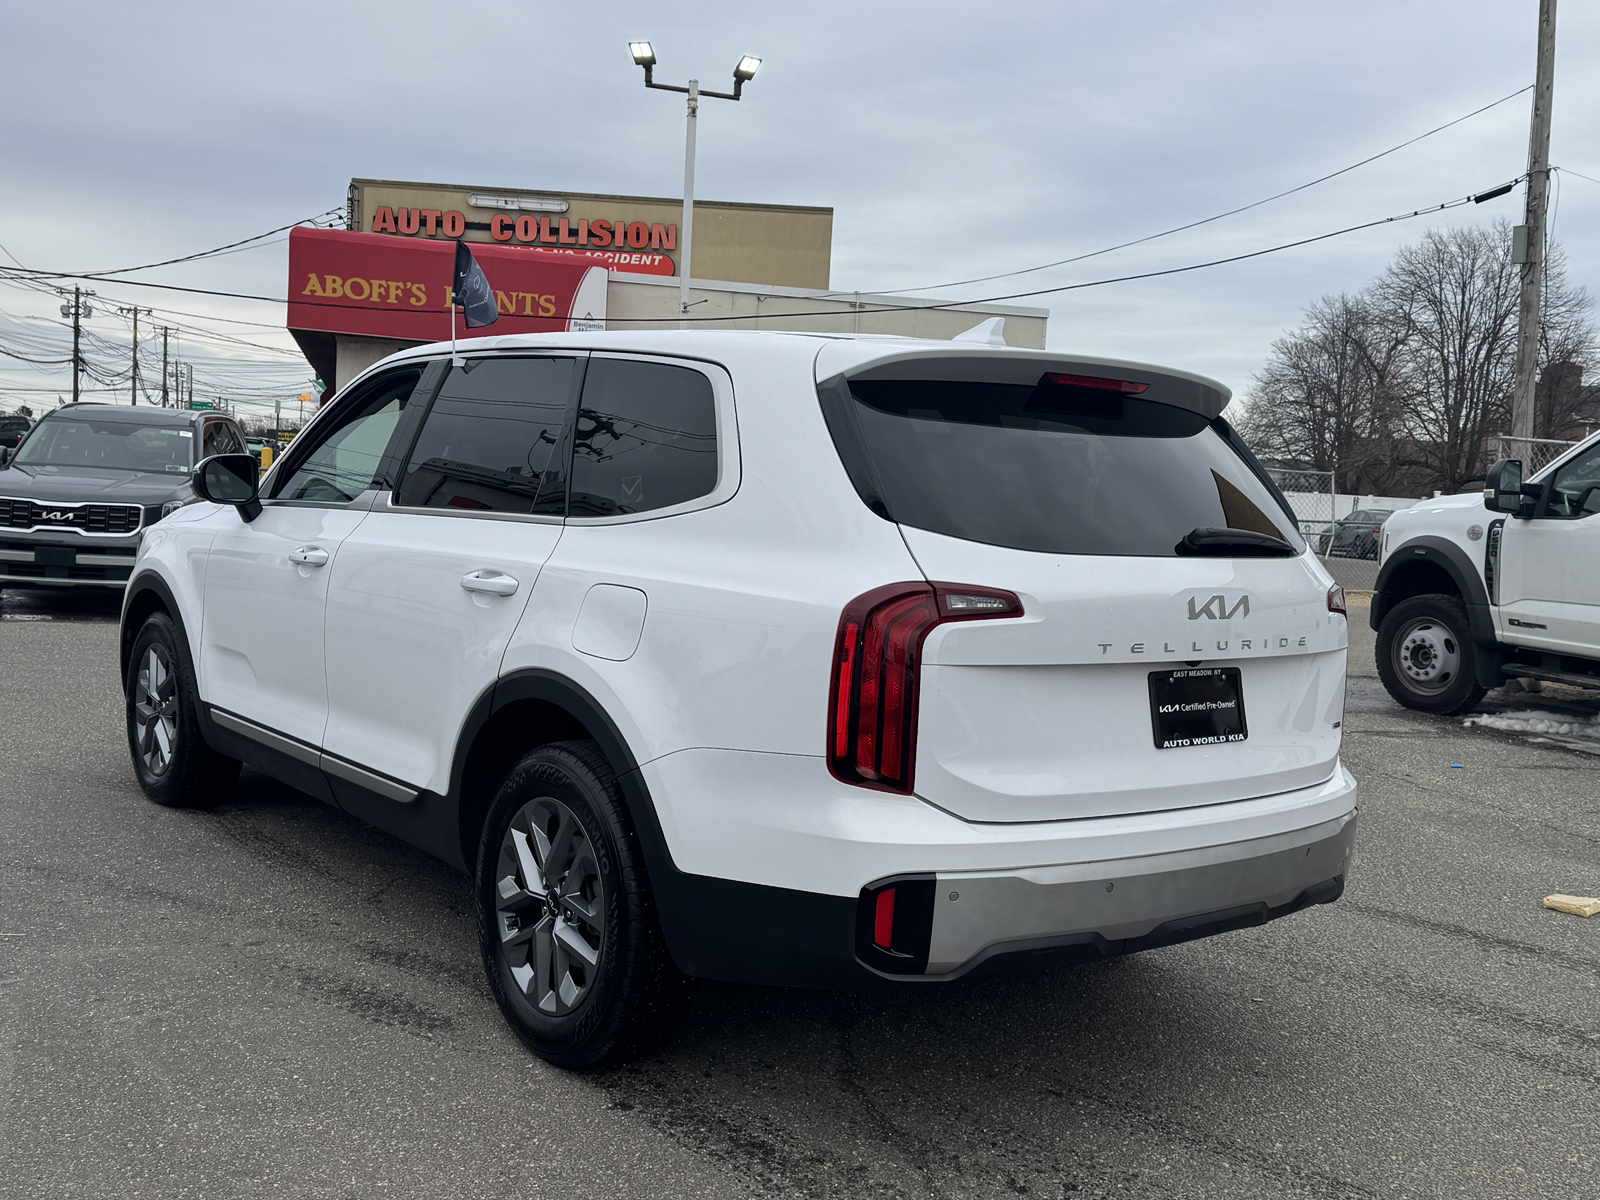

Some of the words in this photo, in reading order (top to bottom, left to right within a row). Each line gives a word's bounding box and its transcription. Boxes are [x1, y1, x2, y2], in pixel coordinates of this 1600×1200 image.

[372, 206, 465, 237] AUTO
[490, 214, 677, 250] COLLISION
[302, 272, 428, 306] ABOFF'S
[443, 285, 557, 317] NTS
[573, 321, 604, 330] Benjamin
[1187, 595, 1250, 620] KIA
[1097, 636, 1308, 655] TELLURIDE
[1159, 704, 1180, 714] KIA
[1181, 703, 1207, 712] Certified
[1163, 739, 1190, 749] AUTO
[1192, 736, 1226, 746] WORLD
[1228, 734, 1245, 742] KIA
